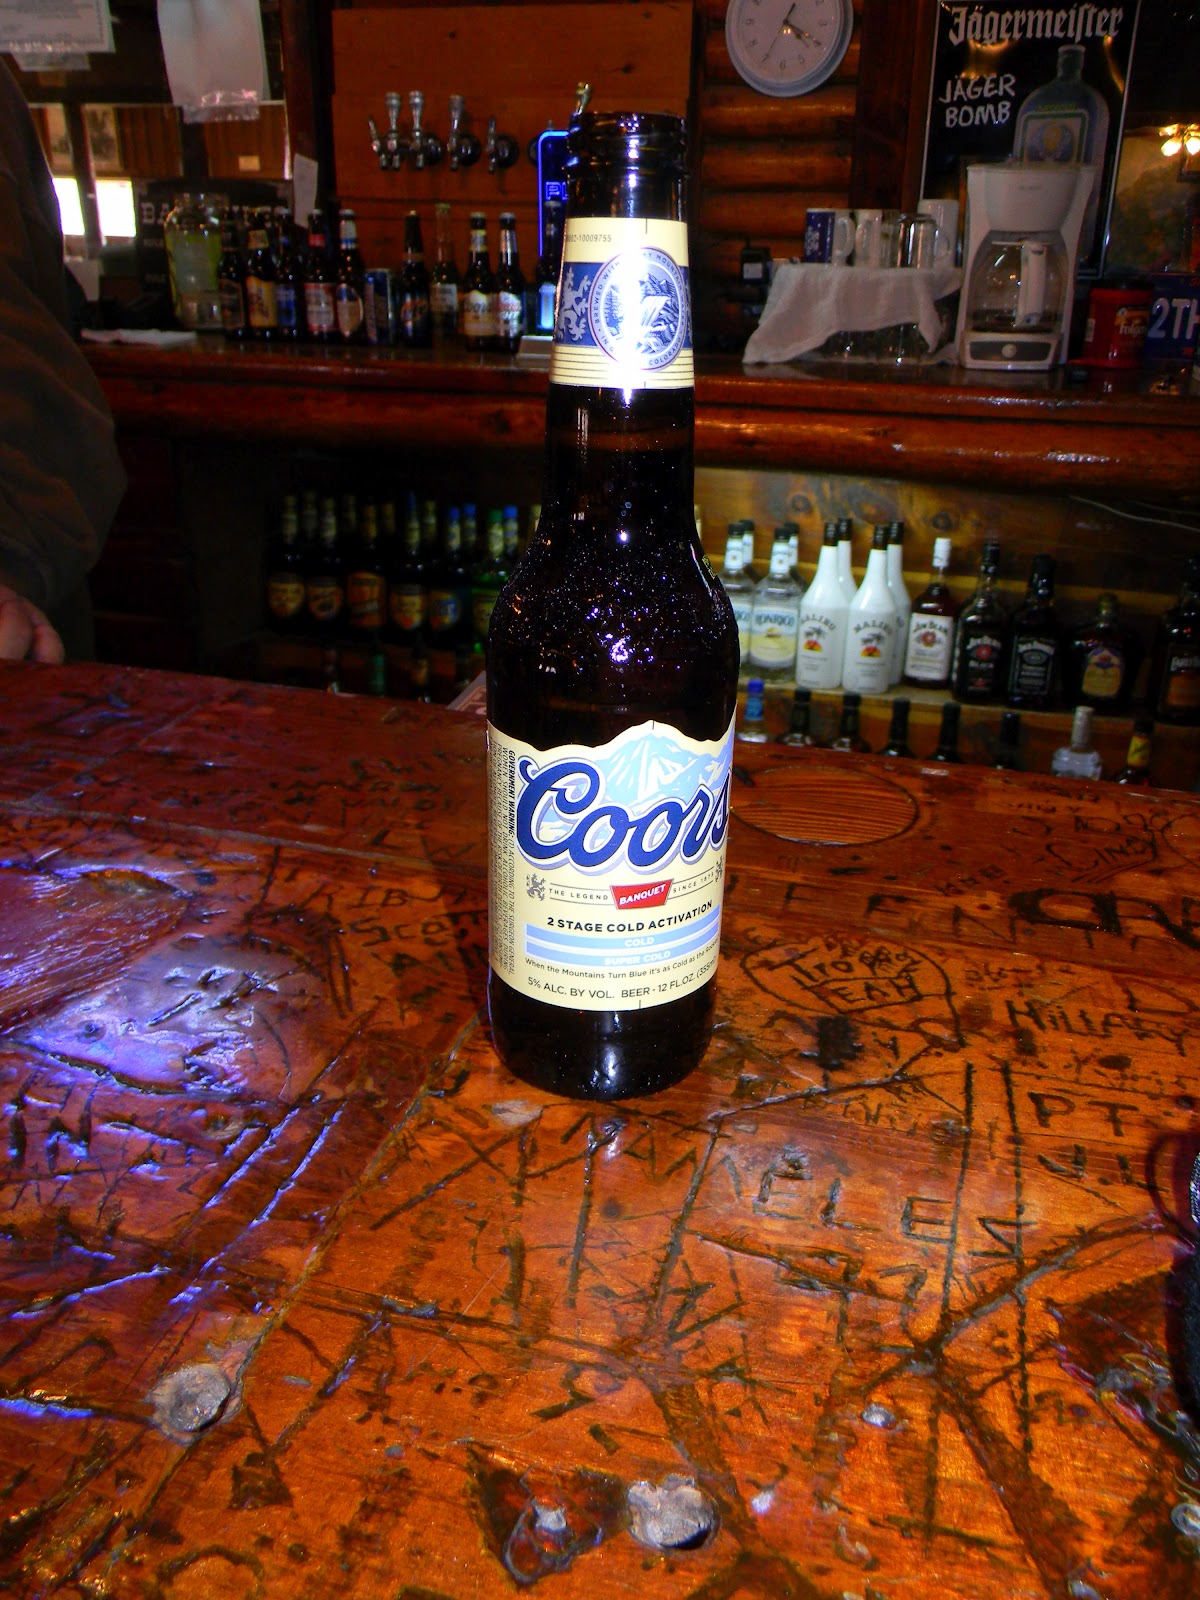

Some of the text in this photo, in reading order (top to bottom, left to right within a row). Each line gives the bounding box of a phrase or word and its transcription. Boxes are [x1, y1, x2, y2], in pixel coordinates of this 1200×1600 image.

[945, 101, 1012, 128] BOMB
[508, 750, 516, 800] GOVERNMENT
[516, 757, 730, 870] Coors
[549, 888, 609, 900] THE LEGEND
[619, 884, 667, 905] BANQUET
[673, 881, 697, 893] SINCE
[547, 900, 712, 932] 2 STAGE COLD ACTIVATION
[624, 937, 655, 947] COLD
[525, 957, 545, 970] When
[547, 965, 560, 973] the
[562, 969, 605, 978] Mountains
[672, 959, 688, 969] Cold
[696, 951, 705, 959] the
[643, 950, 671, 962] COLD
[528, 976, 615, 999] 5% ALC. BY VOL.
[621, 987, 651, 998] BEER
[658, 983, 668, 992] 12
